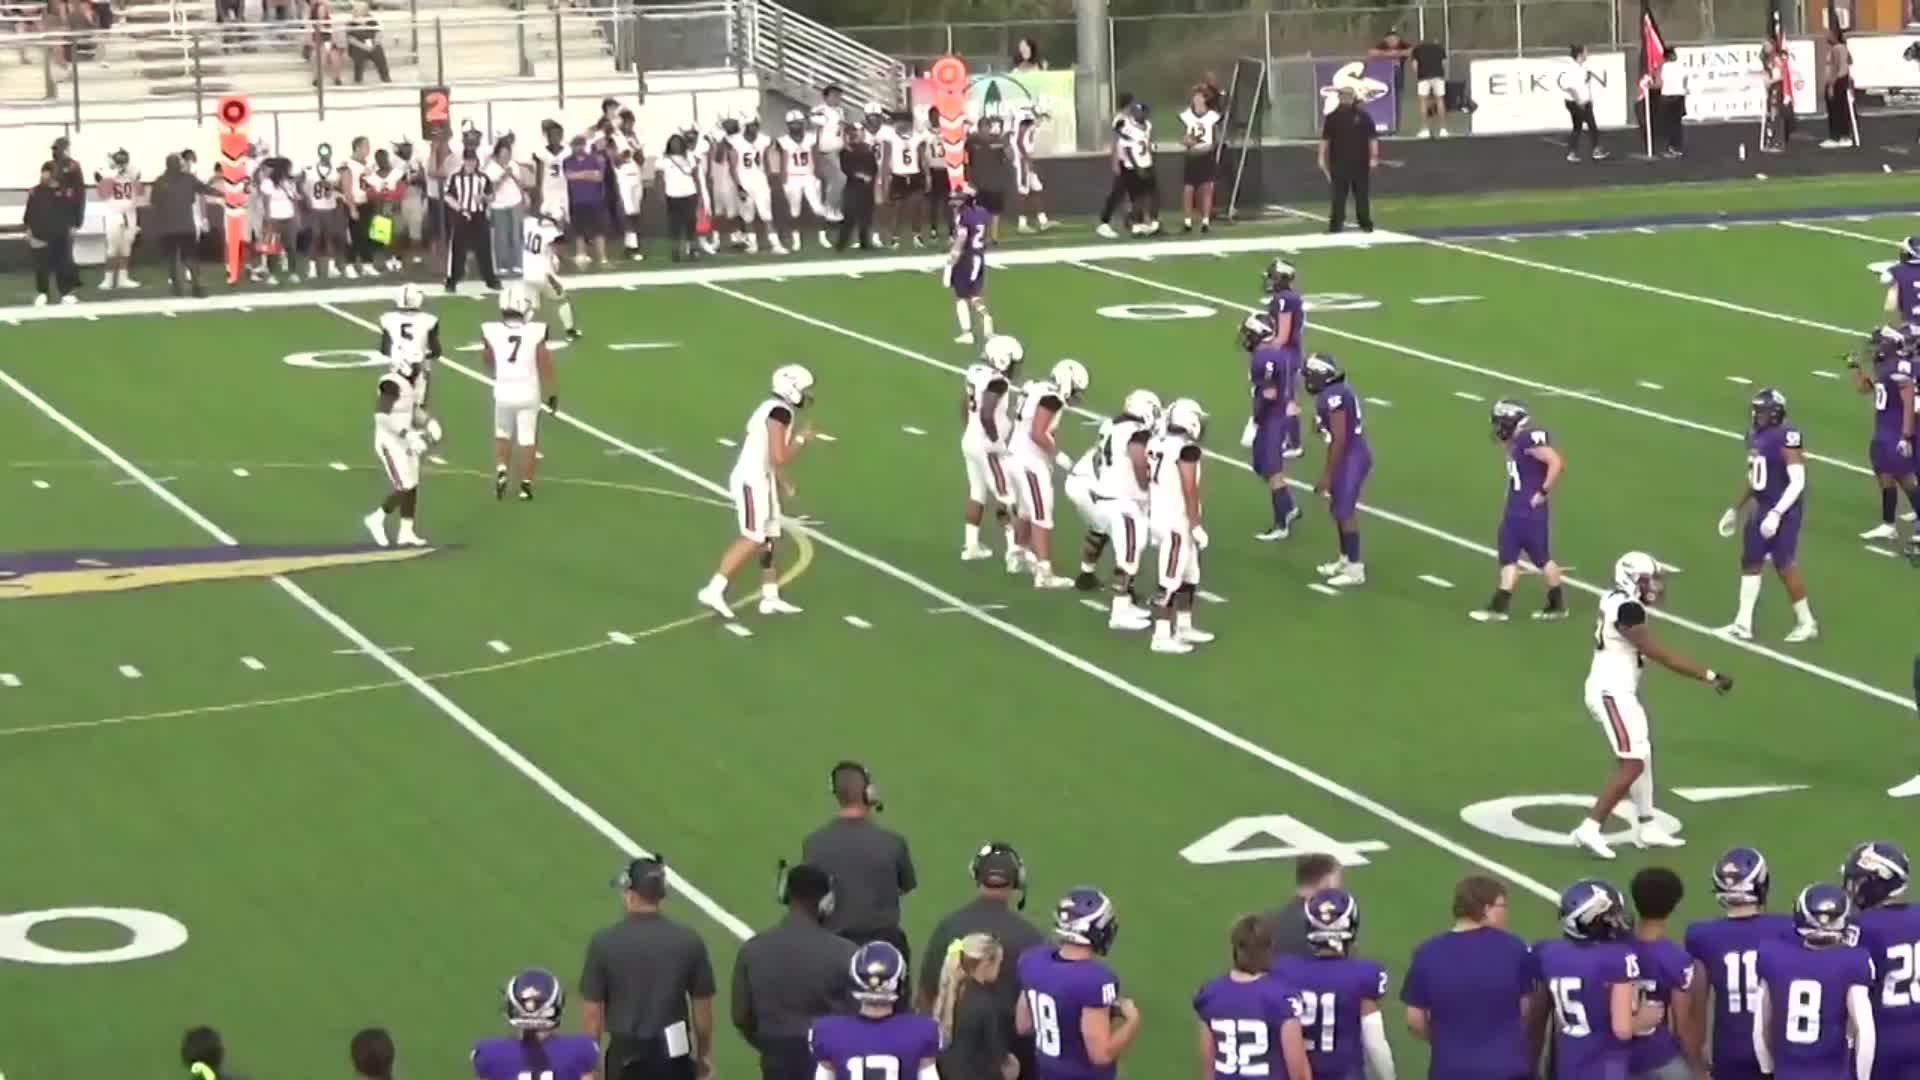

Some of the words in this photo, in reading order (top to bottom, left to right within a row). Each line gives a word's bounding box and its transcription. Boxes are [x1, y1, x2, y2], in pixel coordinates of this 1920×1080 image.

[425, 91, 448, 121] 2
[507, 335, 522, 363] 7
[1549, 976, 1592, 1038] 15
[1723, 949, 1760, 1014] 11
[1785, 978, 1822, 1045] 8
[1027, 988, 1061, 1057] 18
[1210, 1018, 1270, 1077] 32
